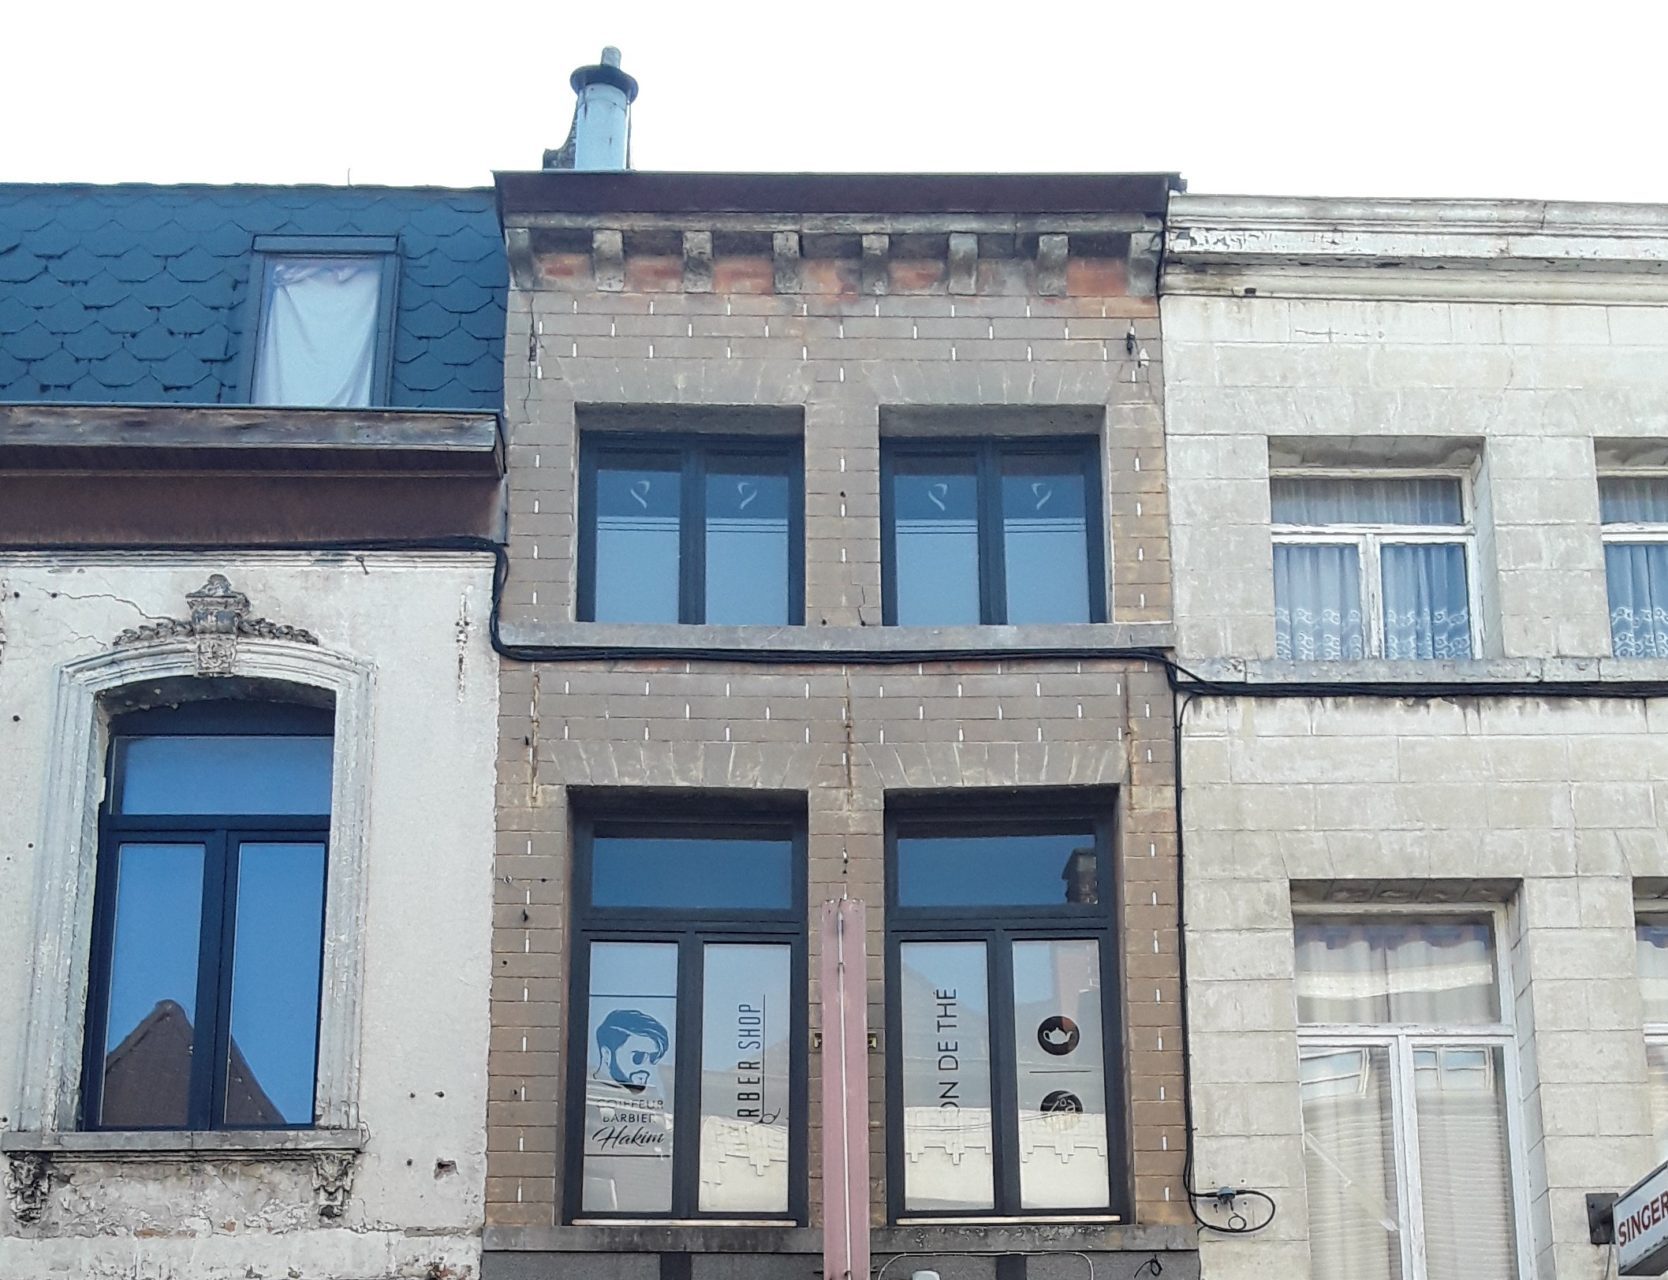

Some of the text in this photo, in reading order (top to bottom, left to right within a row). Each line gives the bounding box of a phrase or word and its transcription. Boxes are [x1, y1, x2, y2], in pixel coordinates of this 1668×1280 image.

[738, 1003, 761, 1050] SHOP
[933, 988, 957, 1033] THÉ
[937, 1041, 959, 1071] DE
[591, 1124, 665, 1151] Hakim
[1617, 1190, 1668, 1248] SINGER
